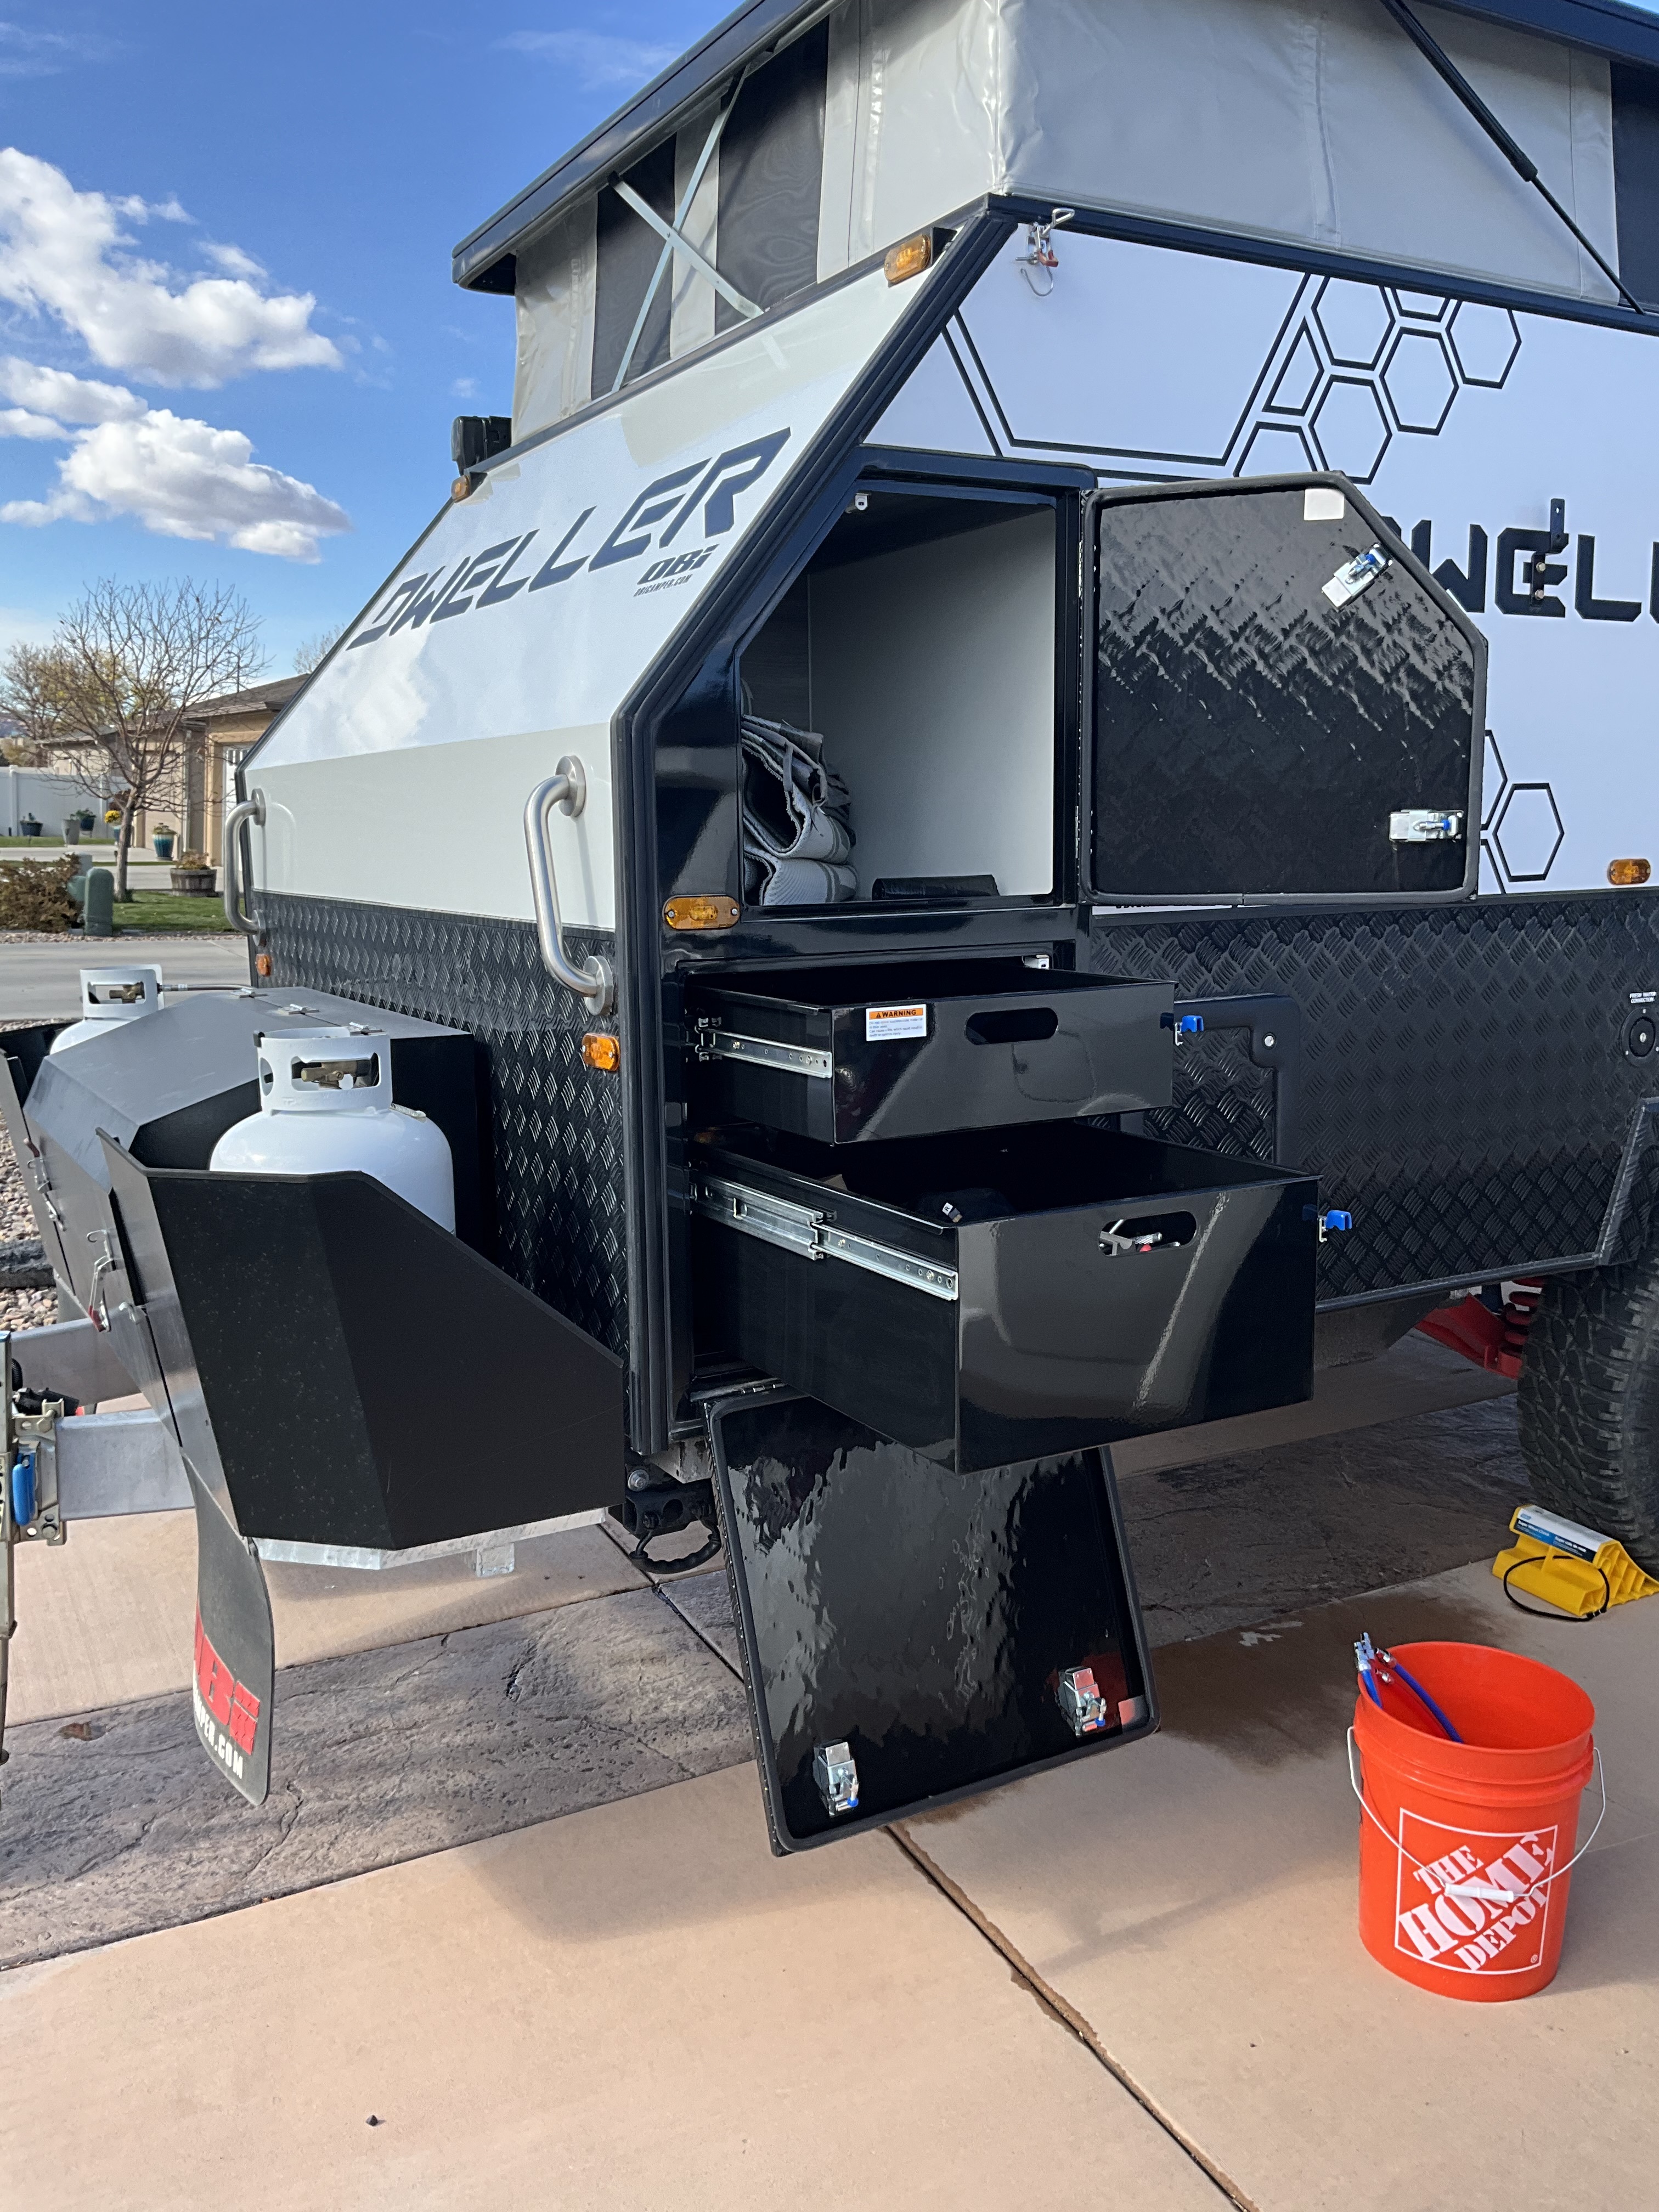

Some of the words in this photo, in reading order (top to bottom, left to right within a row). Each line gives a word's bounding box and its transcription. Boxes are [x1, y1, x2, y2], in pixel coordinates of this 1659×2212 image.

[347, 427, 791, 651] DWELLER
[1383, 516, 1659, 624] WEL
[882, 1009, 916, 1018] WARNING
[194, 1600, 260, 1756] Bi
[1398, 1833, 1554, 1961] HOME
[1413, 1845, 1484, 1894] THE
[1454, 1881, 1548, 1971] DEPOT
